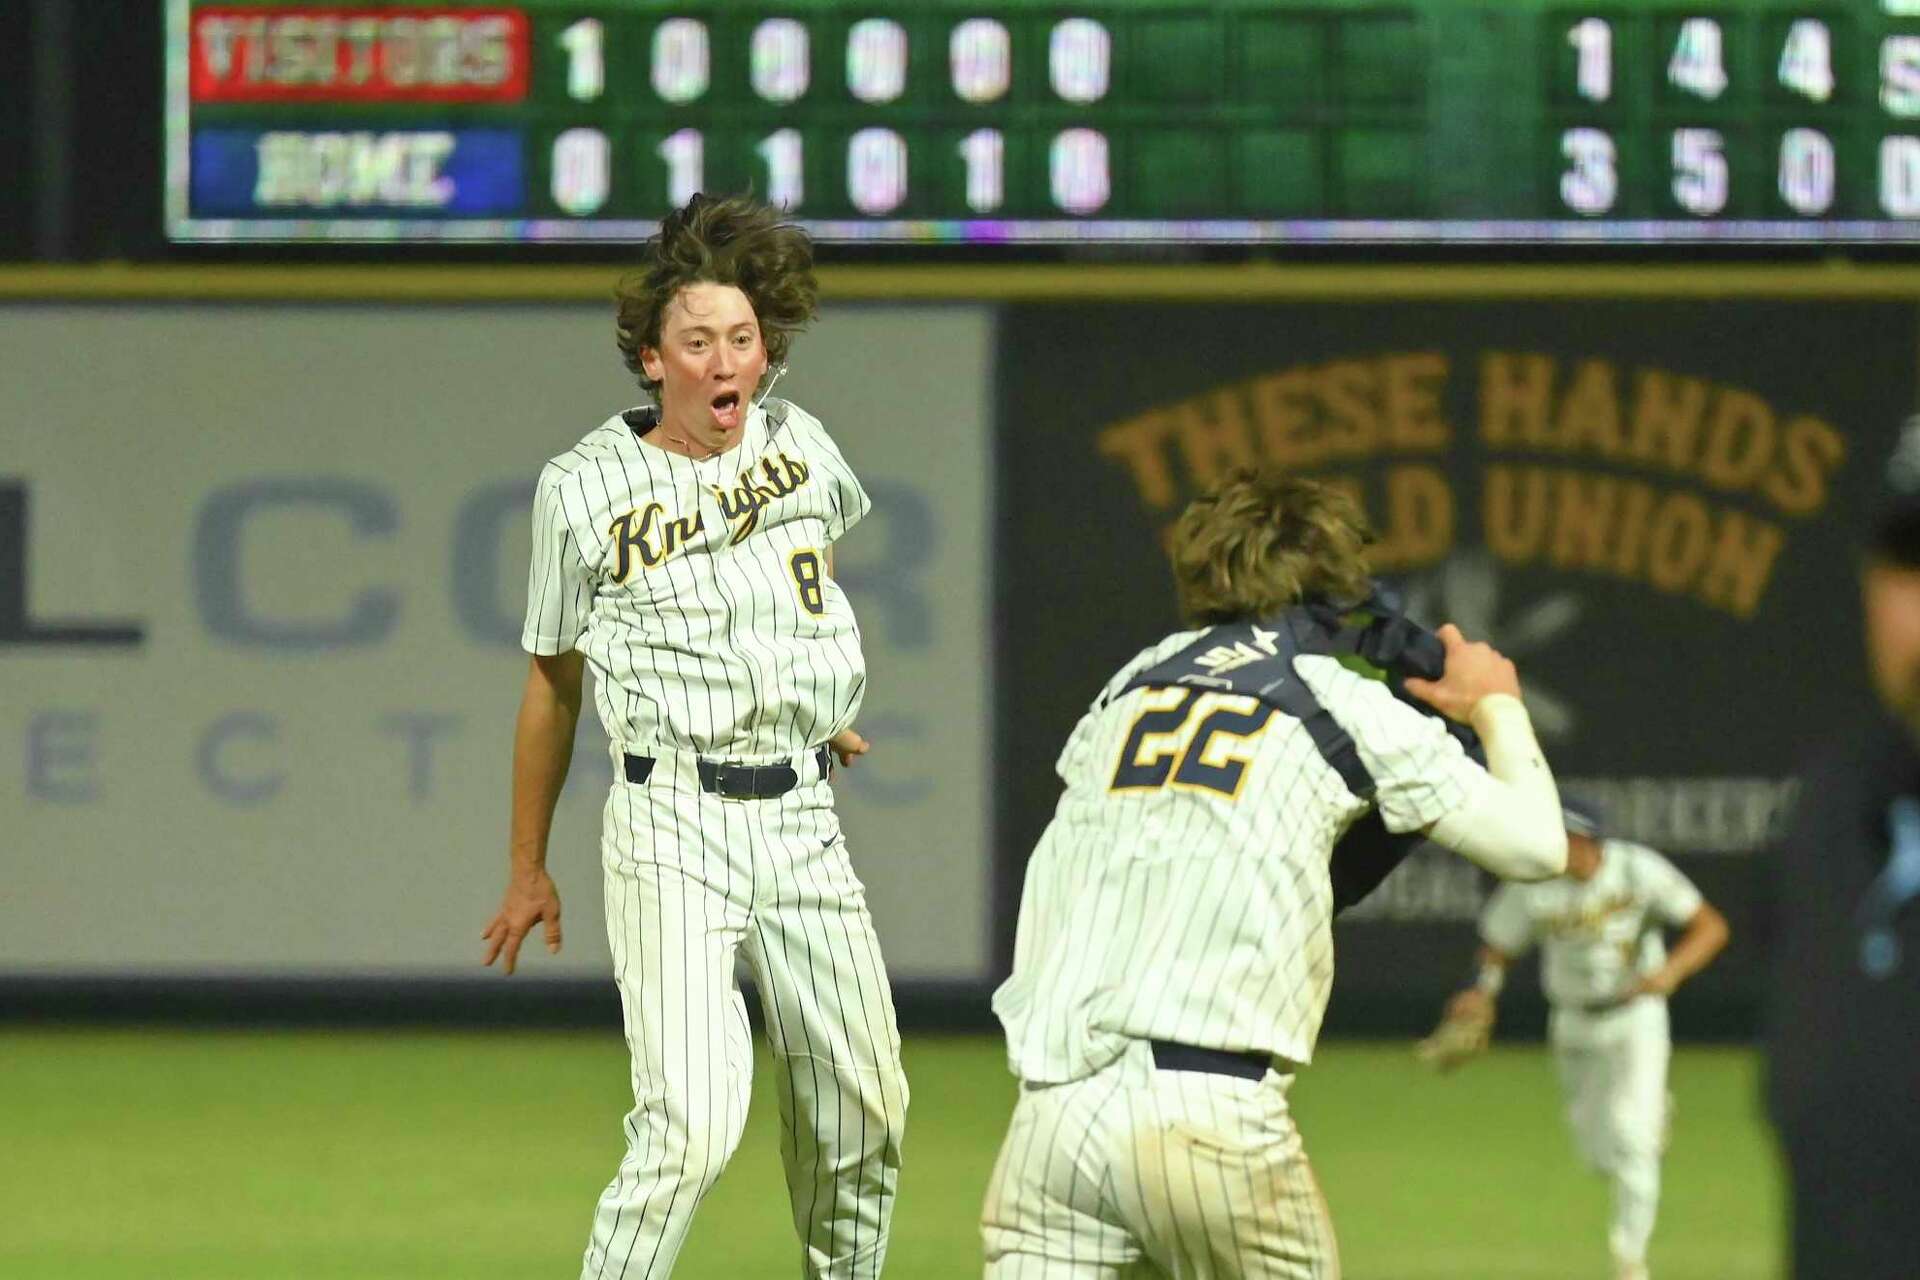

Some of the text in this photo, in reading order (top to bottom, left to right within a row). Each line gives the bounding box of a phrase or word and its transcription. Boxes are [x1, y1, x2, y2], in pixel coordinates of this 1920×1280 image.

[558, 18, 604, 100] 1
[651, 18, 710, 102] 0
[750, 18, 810, 102] 0
[846, 18, 907, 102] 0
[949, 18, 1011, 102] 0
[1049, 18, 1111, 102] 0
[1567, 17, 1612, 101] 1
[1667, 17, 1728, 101] 4
[1778, 17, 1835, 102] 4
[551, 128, 611, 215] 0
[659, 128, 704, 208] 1
[756, 128, 803, 210] 1
[846, 128, 907, 216] 0
[959, 128, 1004, 213] 1
[1560, 127, 1618, 216] 3
[1671, 127, 1728, 216] 5
[1777, 127, 1835, 216] 0
[1098, 350, 1846, 515] THESE HANDS
[607, 452, 809, 585] Knights
[1482, 459, 1786, 618] UNION
[788, 546, 827, 621] 8
[1108, 685, 1281, 805] 22
